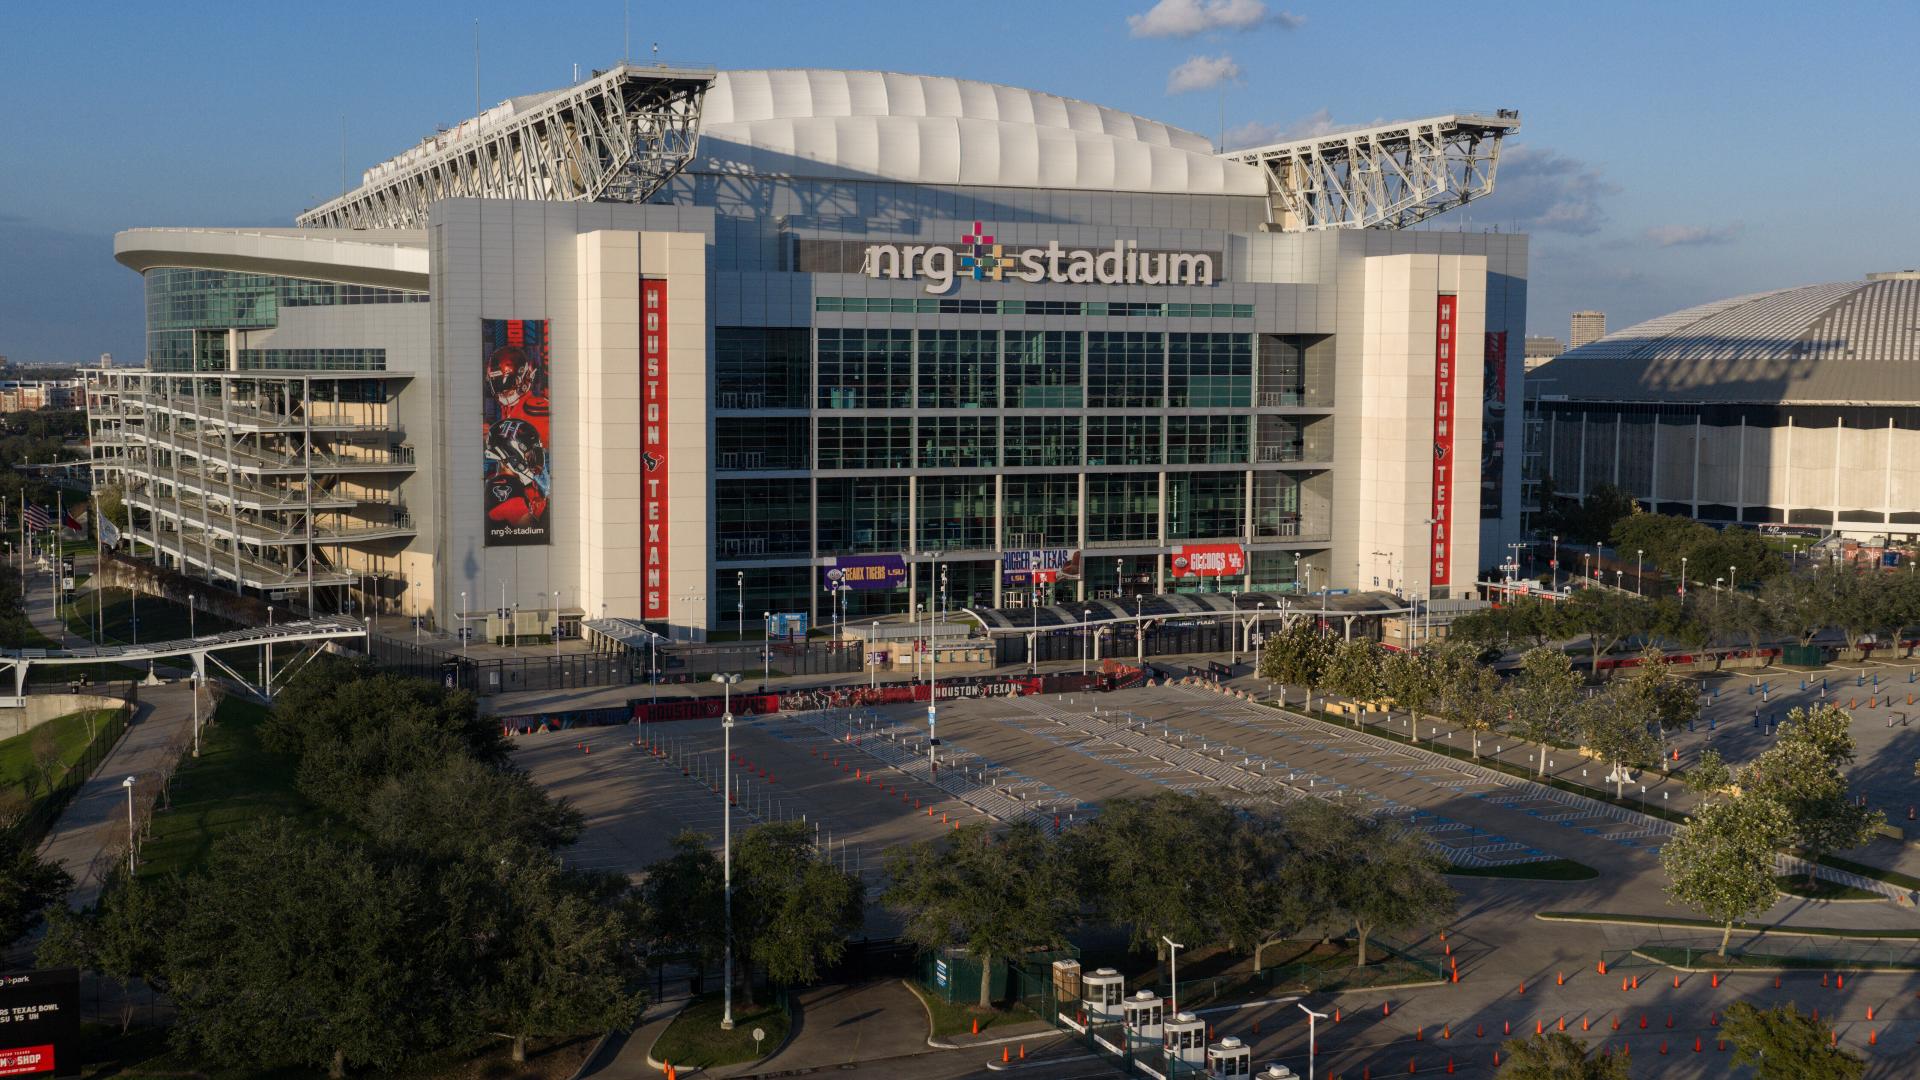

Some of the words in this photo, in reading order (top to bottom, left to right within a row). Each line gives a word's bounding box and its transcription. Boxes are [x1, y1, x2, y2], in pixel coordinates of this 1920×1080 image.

[869, 243, 954, 294] nrg
[1020, 239, 1213, 286] stadium
[647, 289, 660, 446] HOUSTON
[1438, 303, 1451, 437] HOUSTON
[1435, 466, 1446, 578] TEXANS
[491, 528, 505, 537] nrg
[513, 526, 544, 535] stadium
[647, 479, 660, 610] TEXANS
[1003, 551, 1030, 571] BIGGER
[1042, 549, 1068, 570] TEXAS
[845, 567, 865, 581] GEAUX
[865, 565, 886, 580] TIGERS
[887, 568, 904, 576] LSU
[1010, 574, 1025, 582] LSU
[935, 685, 978, 698] HOUSTON
[986, 682, 1023, 695] TEXANS
[648, 702, 704, 722] HOUSTON
[12, 976, 29, 984] park
[12, 1005, 37, 1015] TEXAS
[38, 1003, 59, 1012] BOWL
[17, 1053, 41, 1066] SHOP
